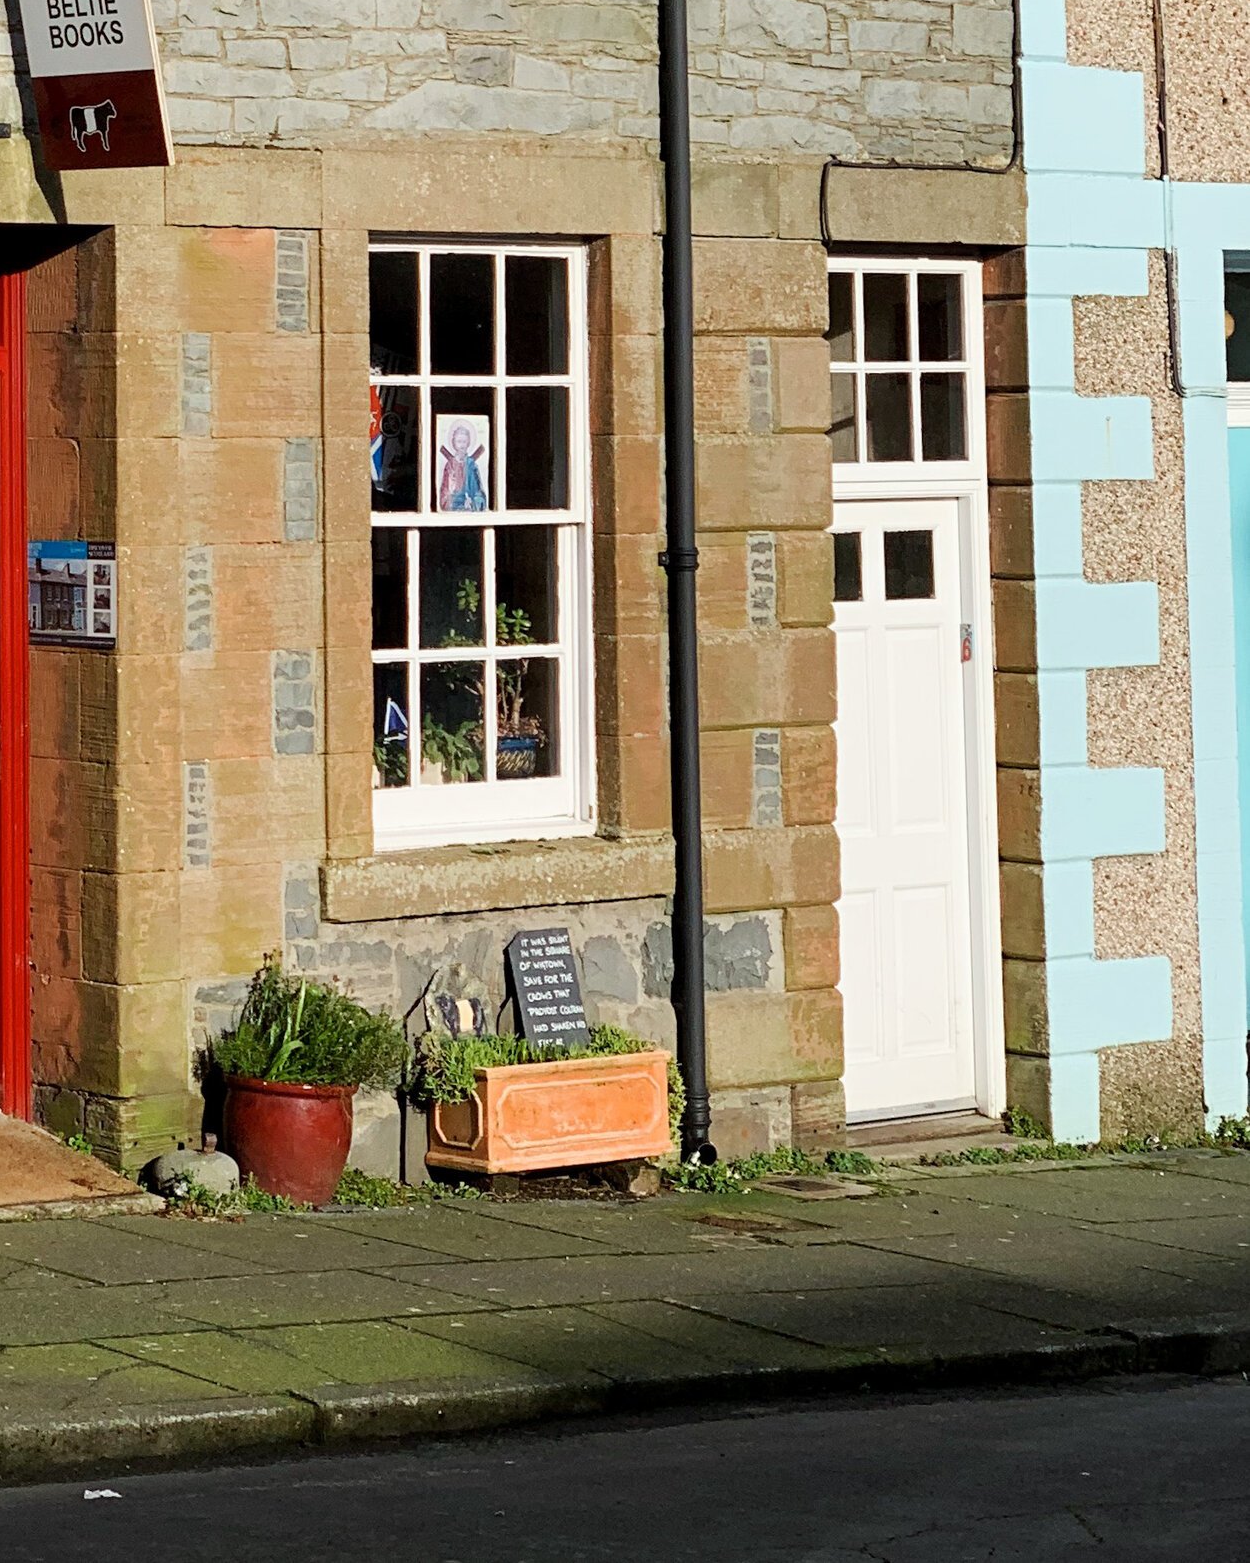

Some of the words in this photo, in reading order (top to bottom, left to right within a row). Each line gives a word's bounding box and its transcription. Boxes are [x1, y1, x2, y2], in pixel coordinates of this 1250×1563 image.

[49, 20, 124, 49] BOOKS
[521, 939, 528, 947] IT
[530, 937, 546, 946] WAS
[548, 935, 568, 945] SILENT
[520, 949, 529, 958] IN
[530, 948, 543, 956] THE
[545, 945, 571, 956] SQUARE
[519, 961, 531, 971] OF
[523, 976, 543, 986] SAVE
[544, 974, 559, 984] FOR
[559, 972, 574, 983] THE
[527, 991, 553, 1002] CROWS
[553, 988, 570, 998] THAT
[533, 1023, 549, 1033] HAD
[550, 1021, 576, 1031] SHAKEN
